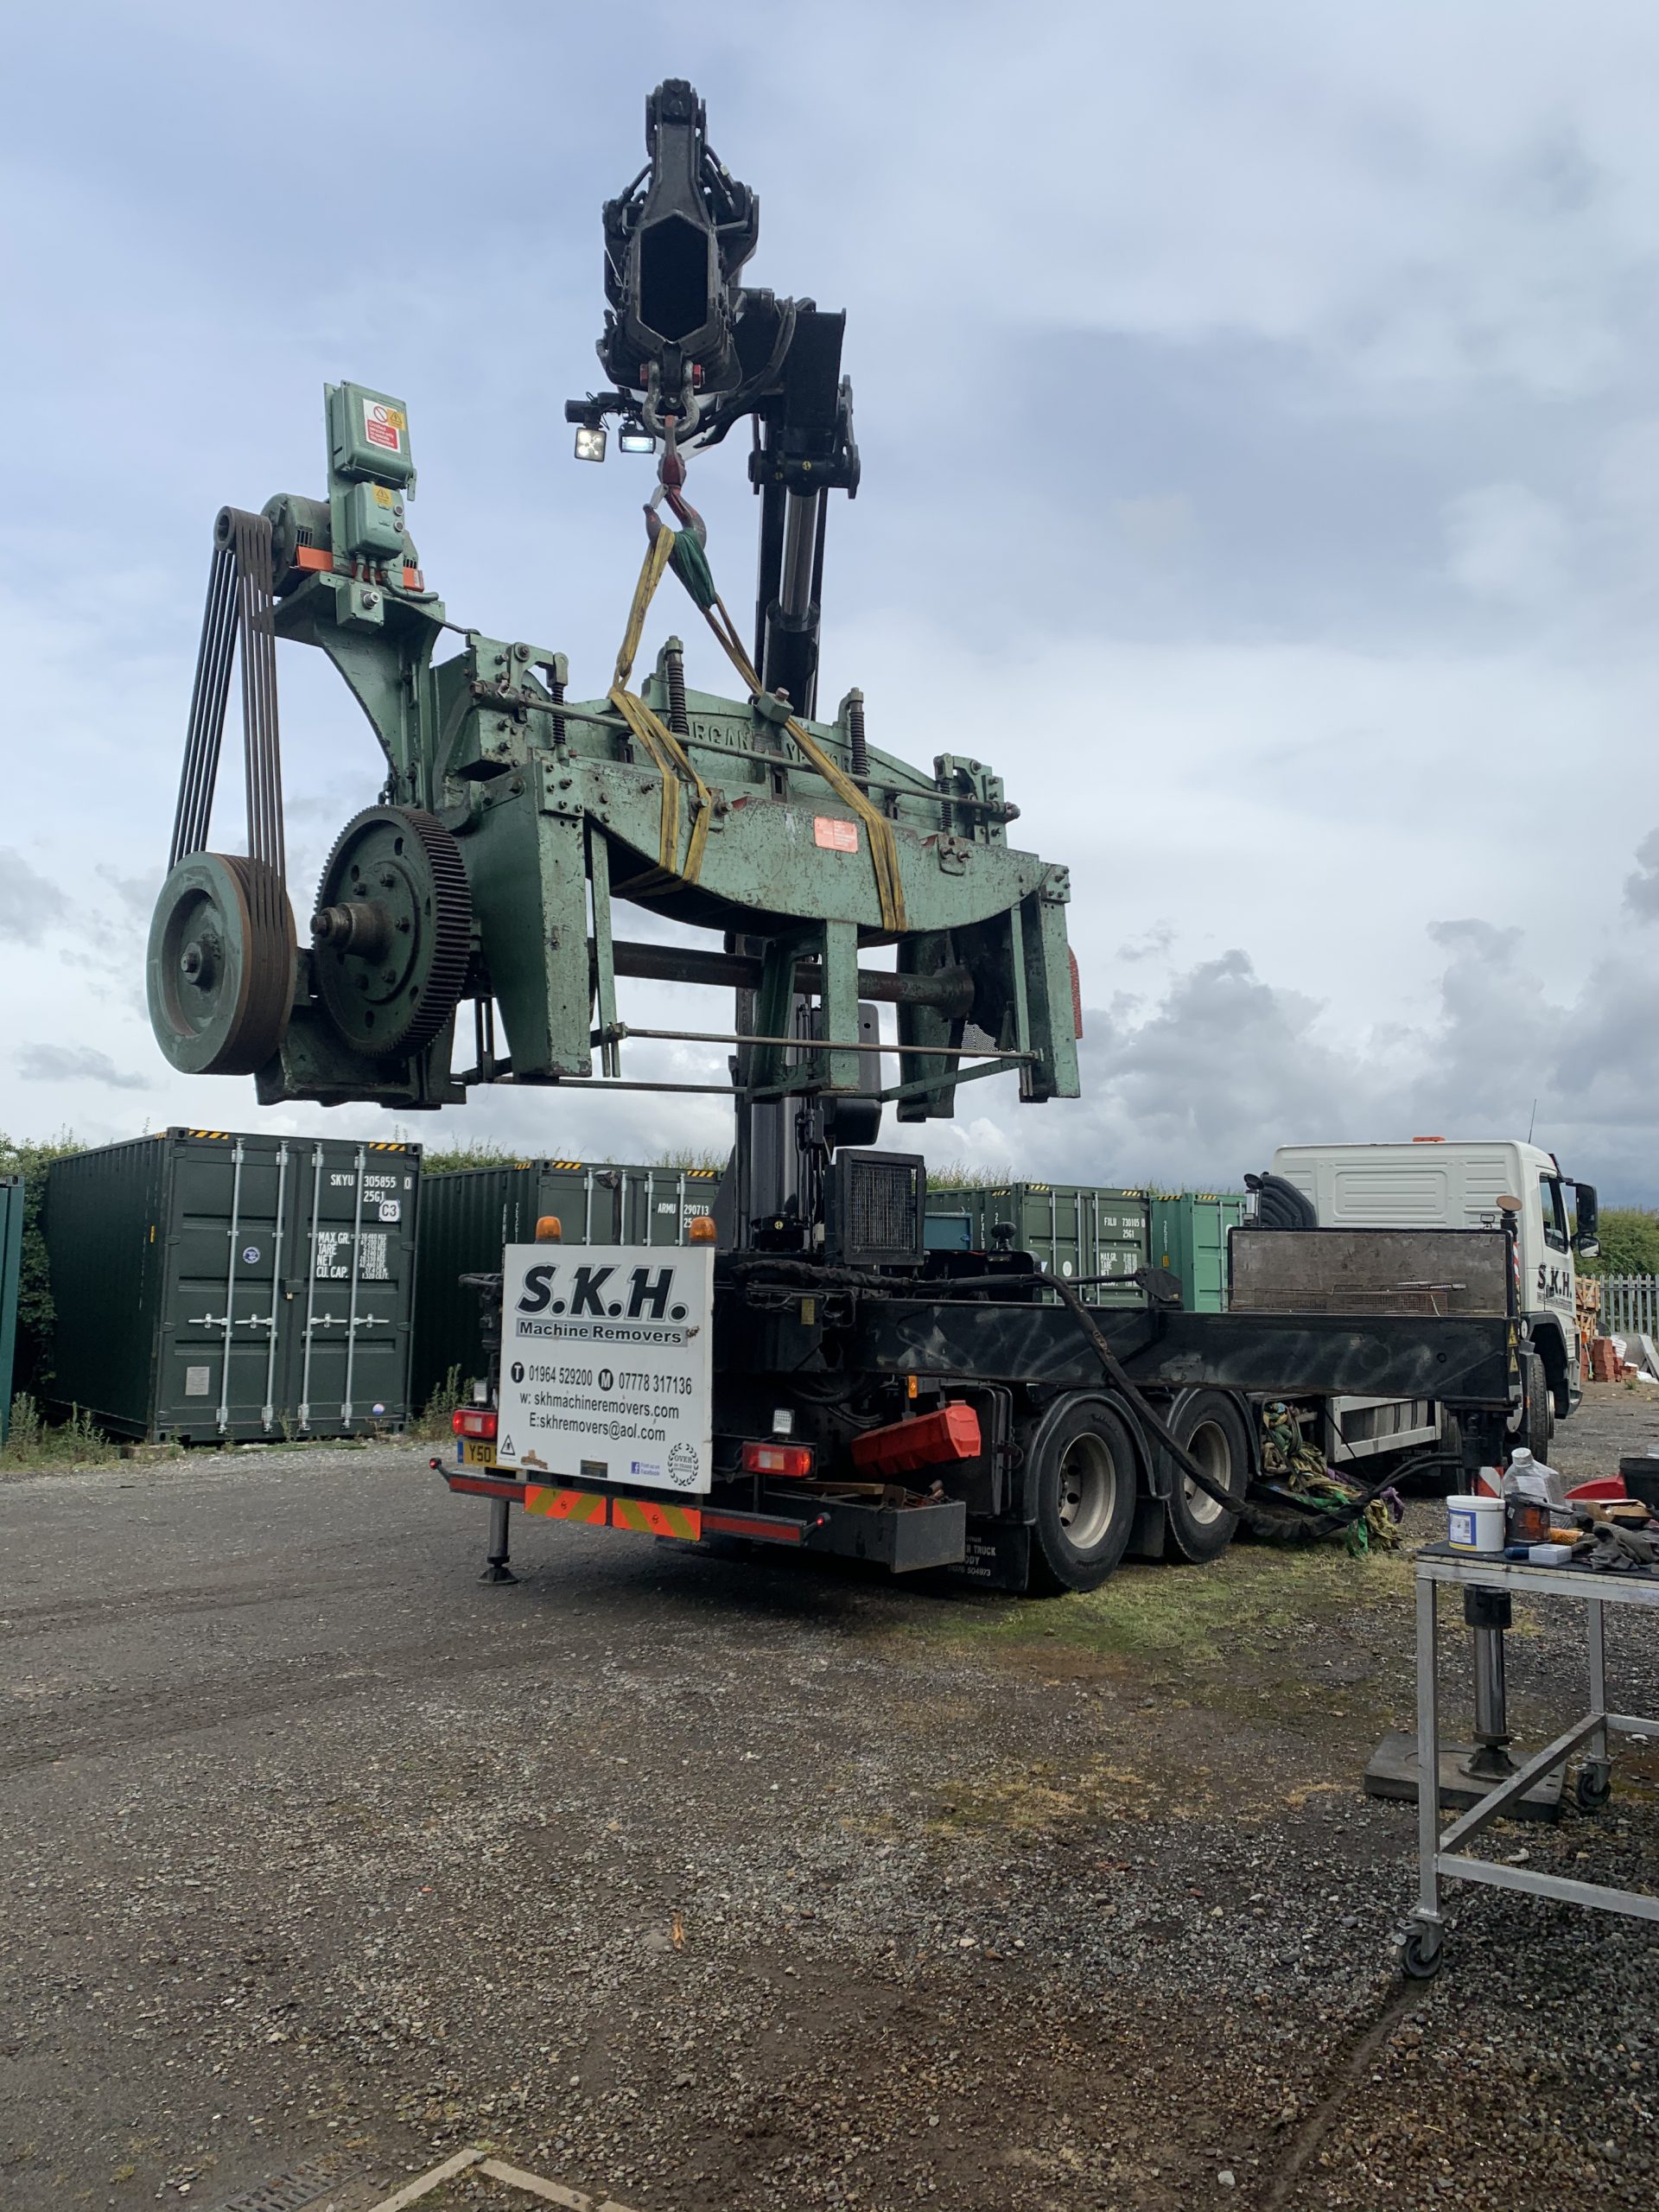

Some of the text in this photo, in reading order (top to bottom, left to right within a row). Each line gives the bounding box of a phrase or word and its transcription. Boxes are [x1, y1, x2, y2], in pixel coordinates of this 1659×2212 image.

[330, 1174, 412, 1190] SKYU 305855 0
[382, 1204, 397, 1217] C3
[658, 1203, 709, 1216] ARMU 290713
[1104, 1217, 1117, 1226] FXLU
[1122, 1217, 1140, 1227] 730105
[318, 1243, 338, 1255] TARE
[316, 1255, 334, 1267] NET
[1101, 1261, 1112, 1270] TARE
[516, 1262, 689, 1322] S.K.H.
[519, 1322, 682, 1344] Machine Removers
[529, 1364, 556, 1382] 01964
[558, 1367, 592, 1386] 529200
[599, 1370, 613, 1390] M
[619, 1372, 649, 1392] 07778
[652, 1375, 692, 1395] 317136
[534, 1391, 679, 1419] skhmachineremovers.com
[530, 1413, 665, 1442] E:skhremovers@aol.com
[974, 1545, 995, 1556] TRUCK
